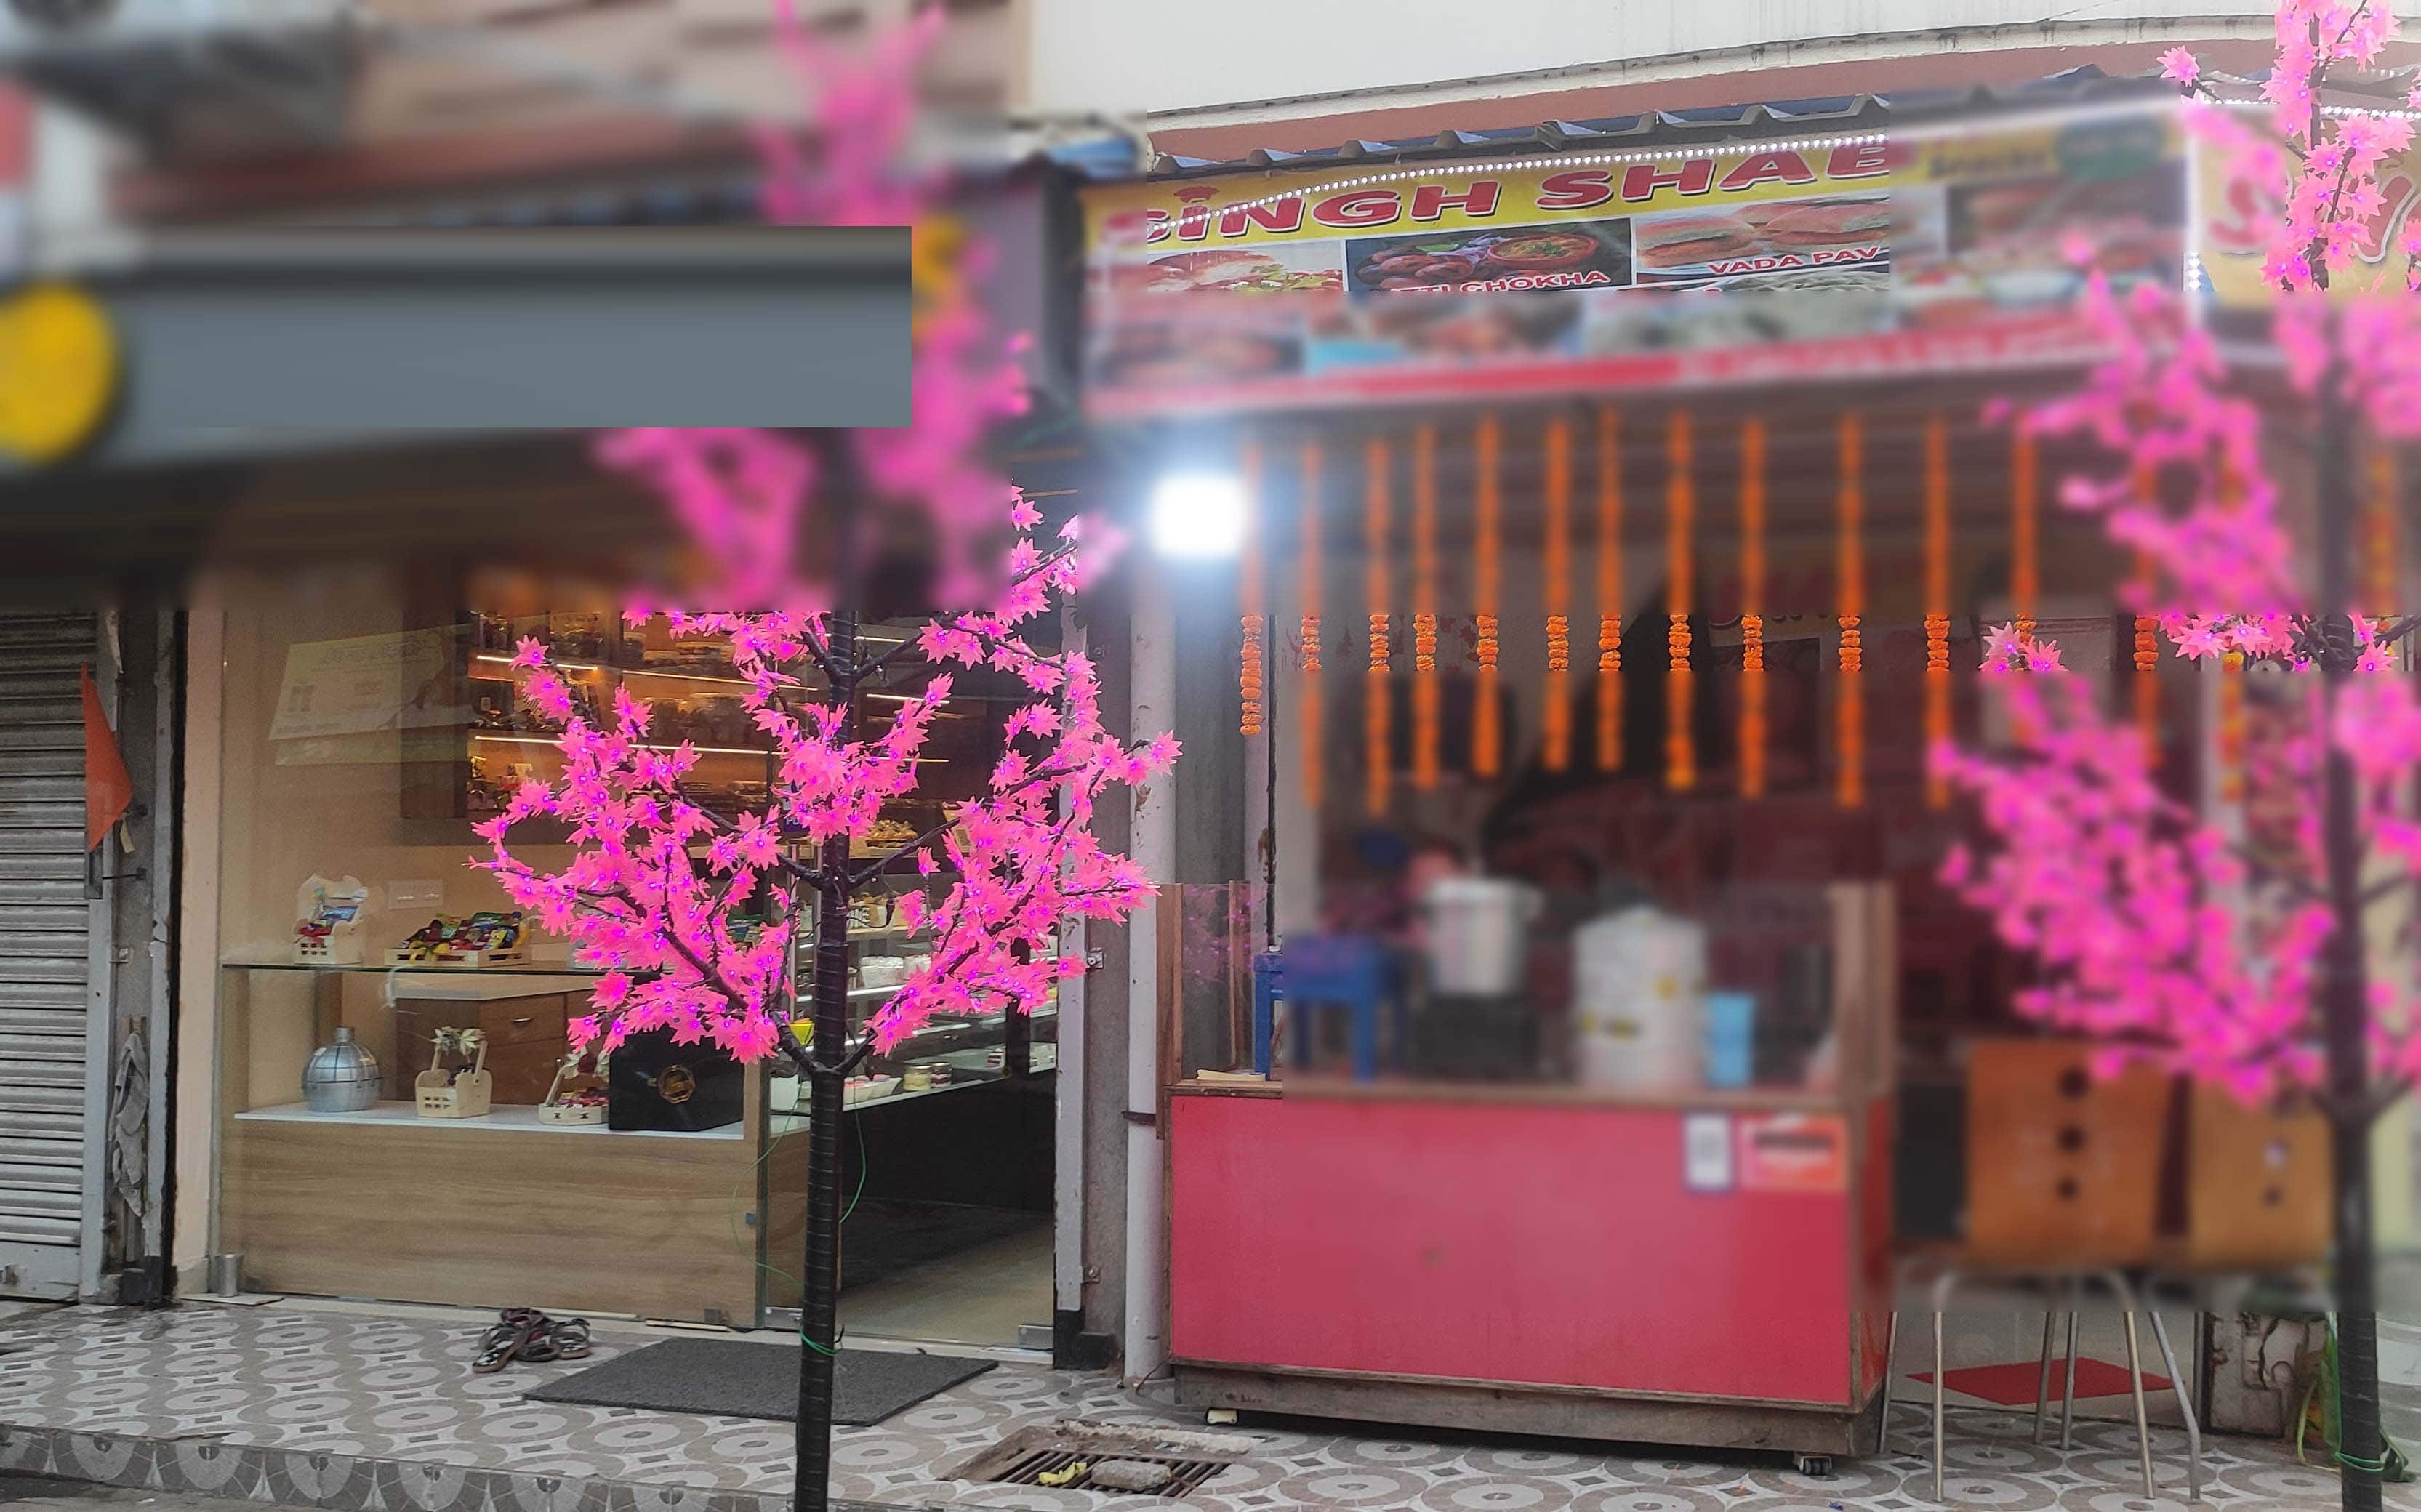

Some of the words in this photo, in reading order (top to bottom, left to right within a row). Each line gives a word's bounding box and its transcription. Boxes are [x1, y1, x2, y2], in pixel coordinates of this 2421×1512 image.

[1708, 255, 1804, 275] VADA
[1812, 246, 1881, 264] PAV
[1461, 270, 1611, 292] CHOKHA
